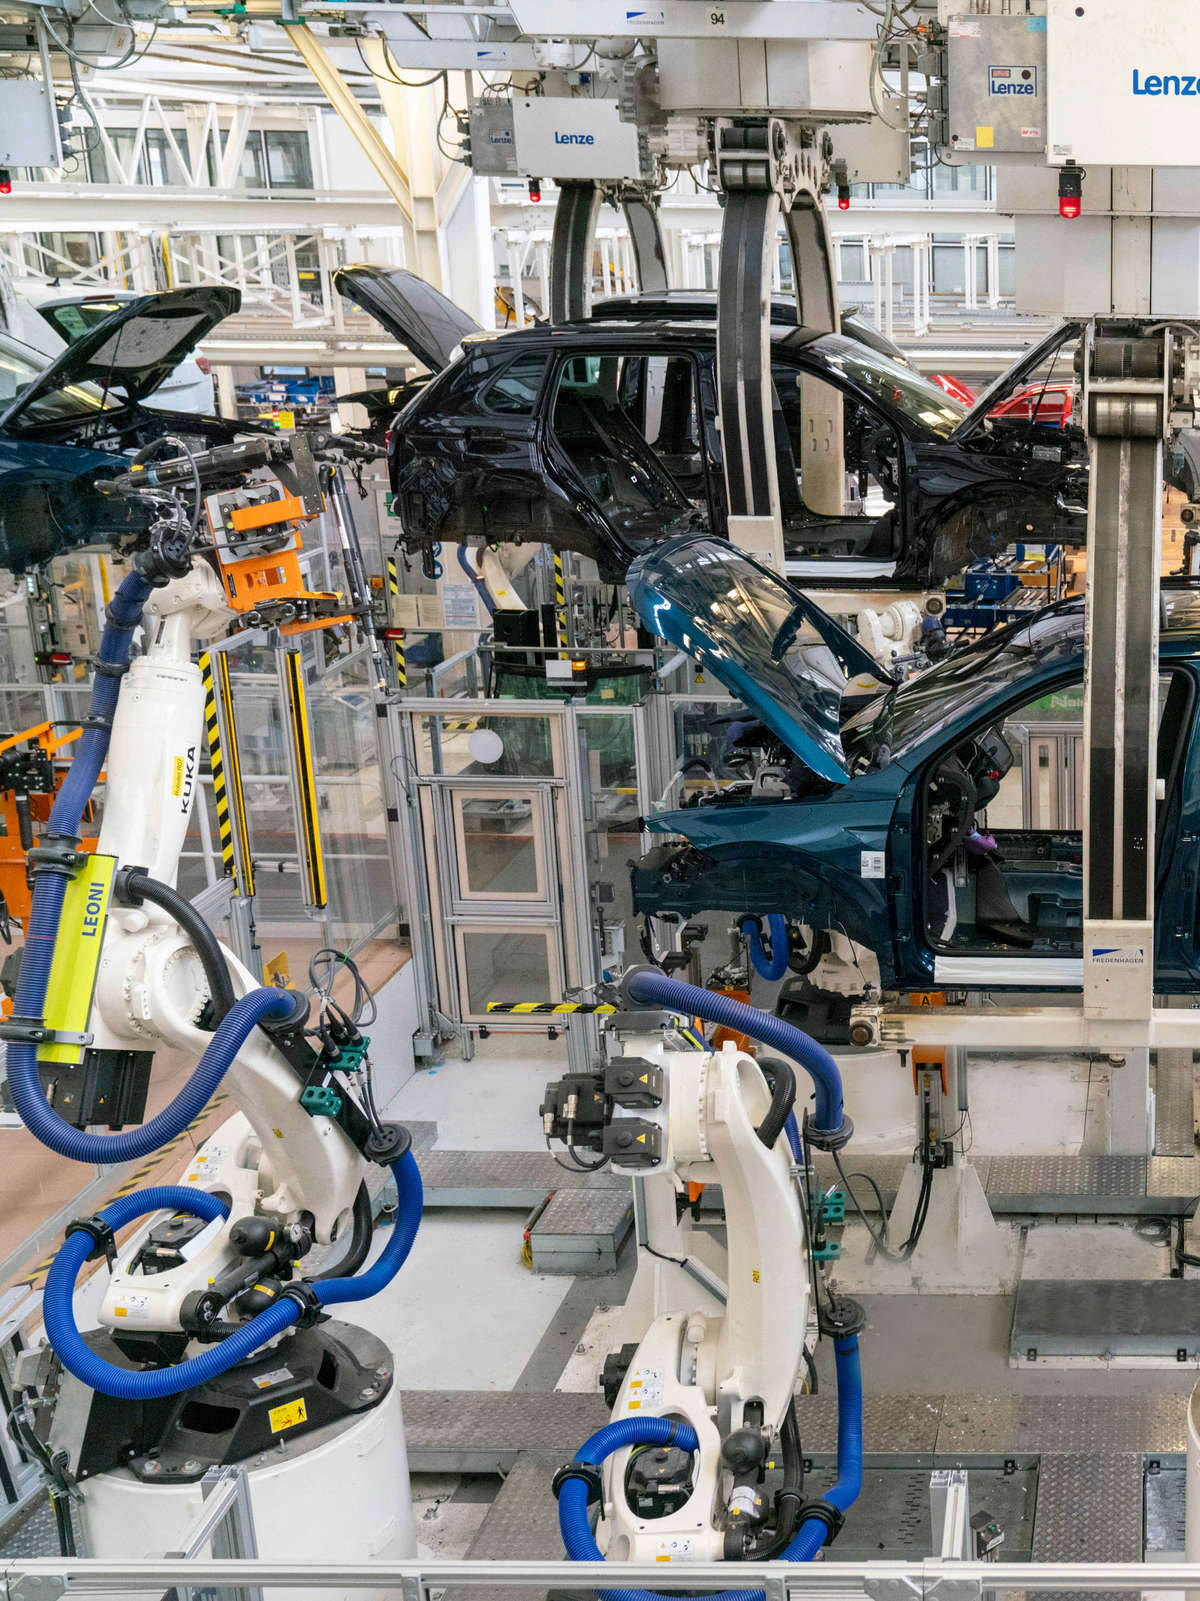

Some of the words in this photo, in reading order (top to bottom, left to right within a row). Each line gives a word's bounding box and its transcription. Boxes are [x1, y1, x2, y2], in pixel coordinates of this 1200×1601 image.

[711, 13, 725, 25] 94
[991, 80, 1034, 95] Lenze
[555, 132, 594, 145] Lenze
[181, 746, 196, 814] KUKA
[81, 881, 105, 937] LEONI
